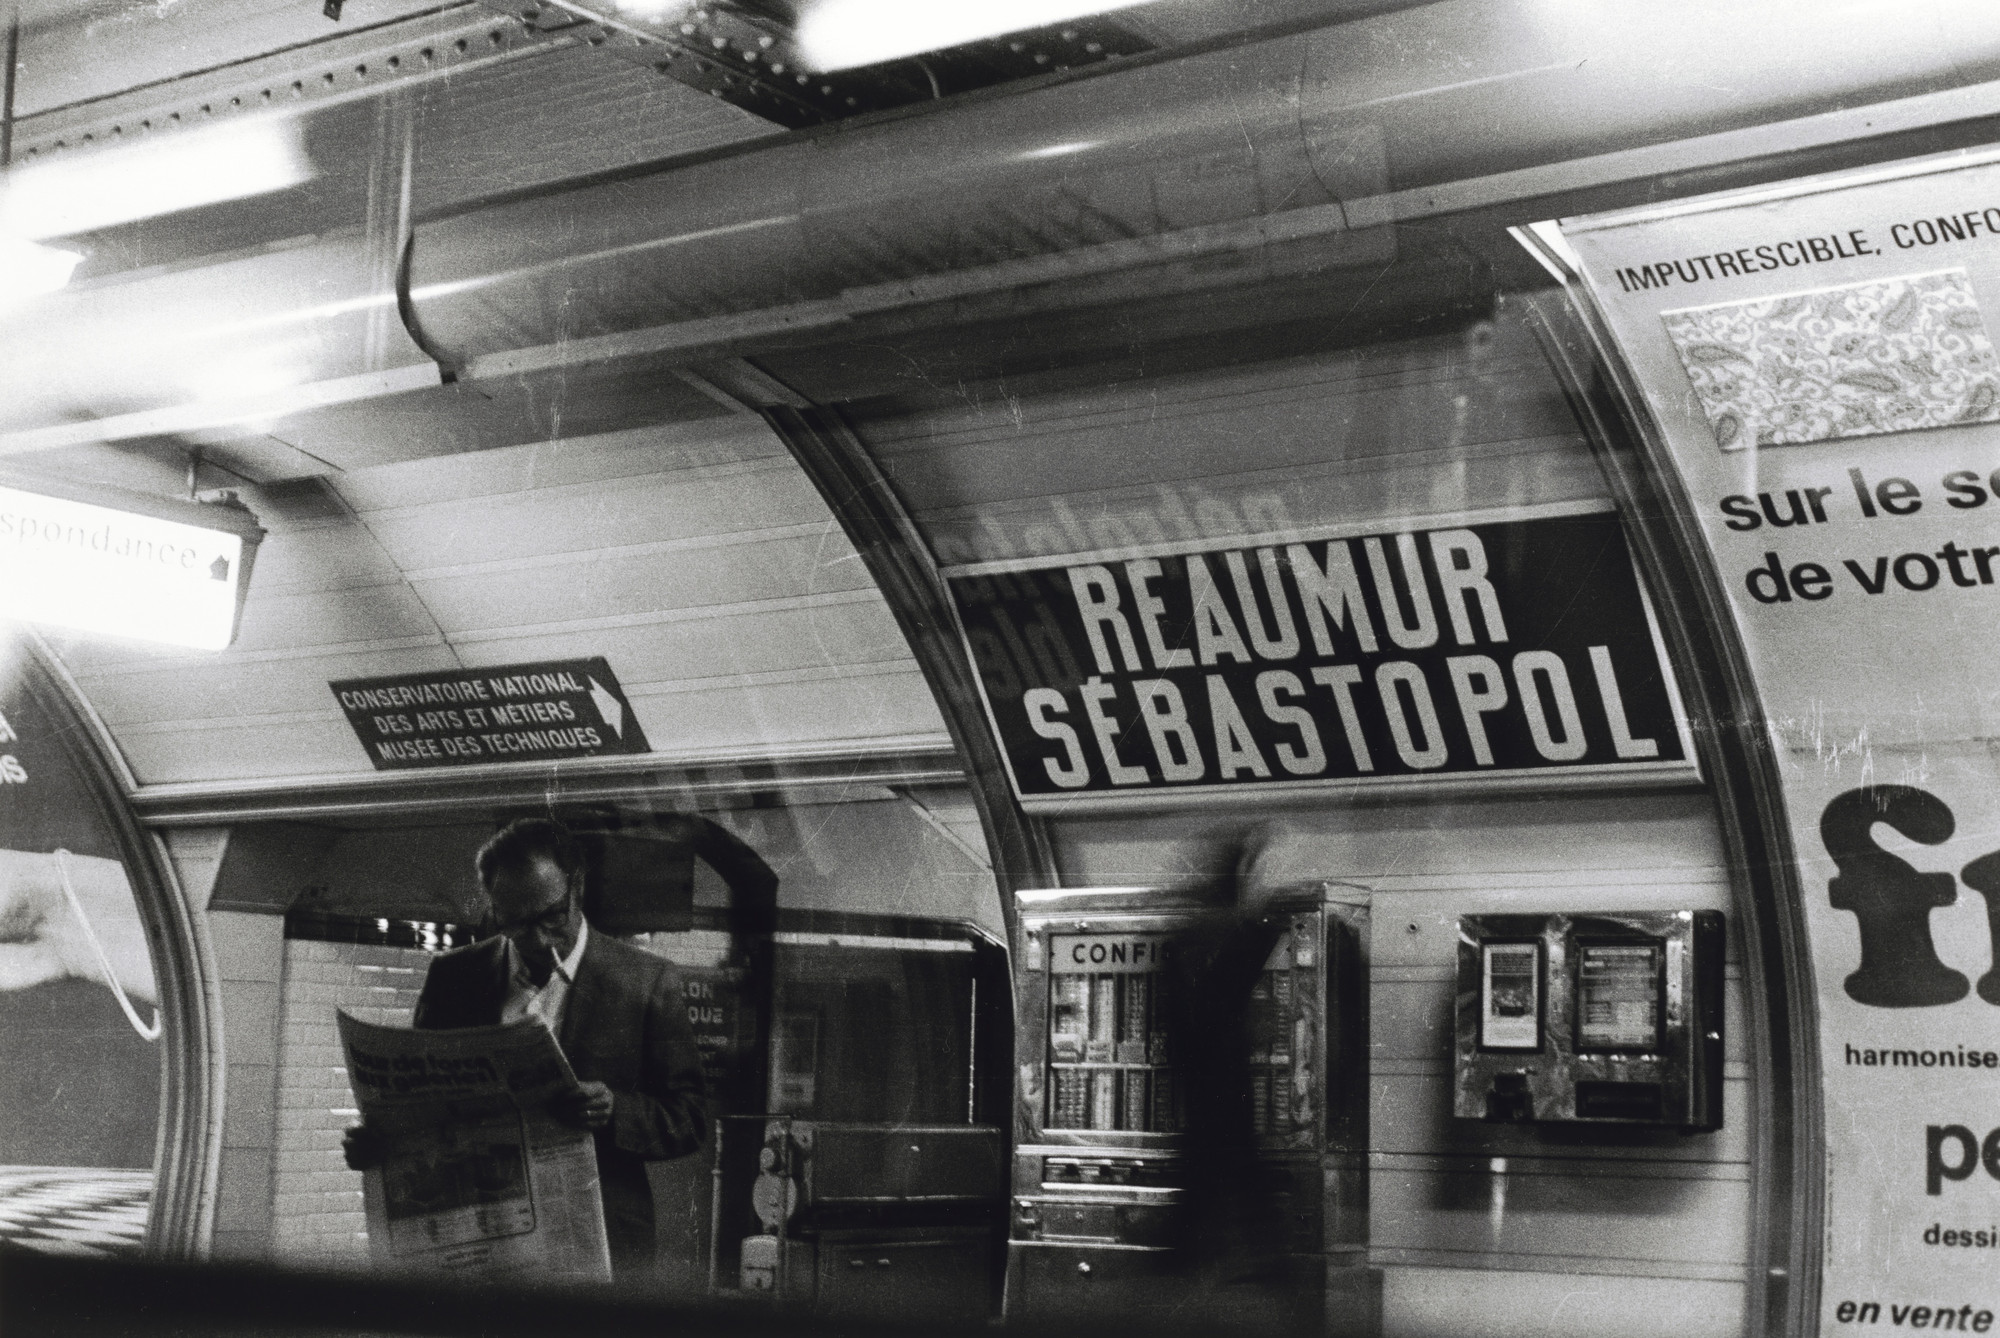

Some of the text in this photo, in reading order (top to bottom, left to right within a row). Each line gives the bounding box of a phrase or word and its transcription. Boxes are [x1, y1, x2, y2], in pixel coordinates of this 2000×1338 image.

[1615, 207, 2000, 293] IMPUTRESCIBLE, CONFO
[1719, 487, 1831, 533] sur
[1848, 467, 1924, 520] le
[0, 512, 197, 569] spondance
[1744, 539, 2000, 605] de votr
[340, 671, 585, 710] CONSERVATOIRE NATIONAL
[373, 713, 414, 735] DES
[416, 709, 464, 731] ARTS
[463, 707, 488, 728] ET
[1022, 645, 1660, 789] SÉBASTOPOL
[440, 735, 482, 756] DES
[480, 726, 602, 754] TECHNIQUES
[1845, 1042, 1999, 1069] harmonise
[1923, 1222, 1999, 1248] dessi
[1836, 1300, 1994, 1334] en vente
